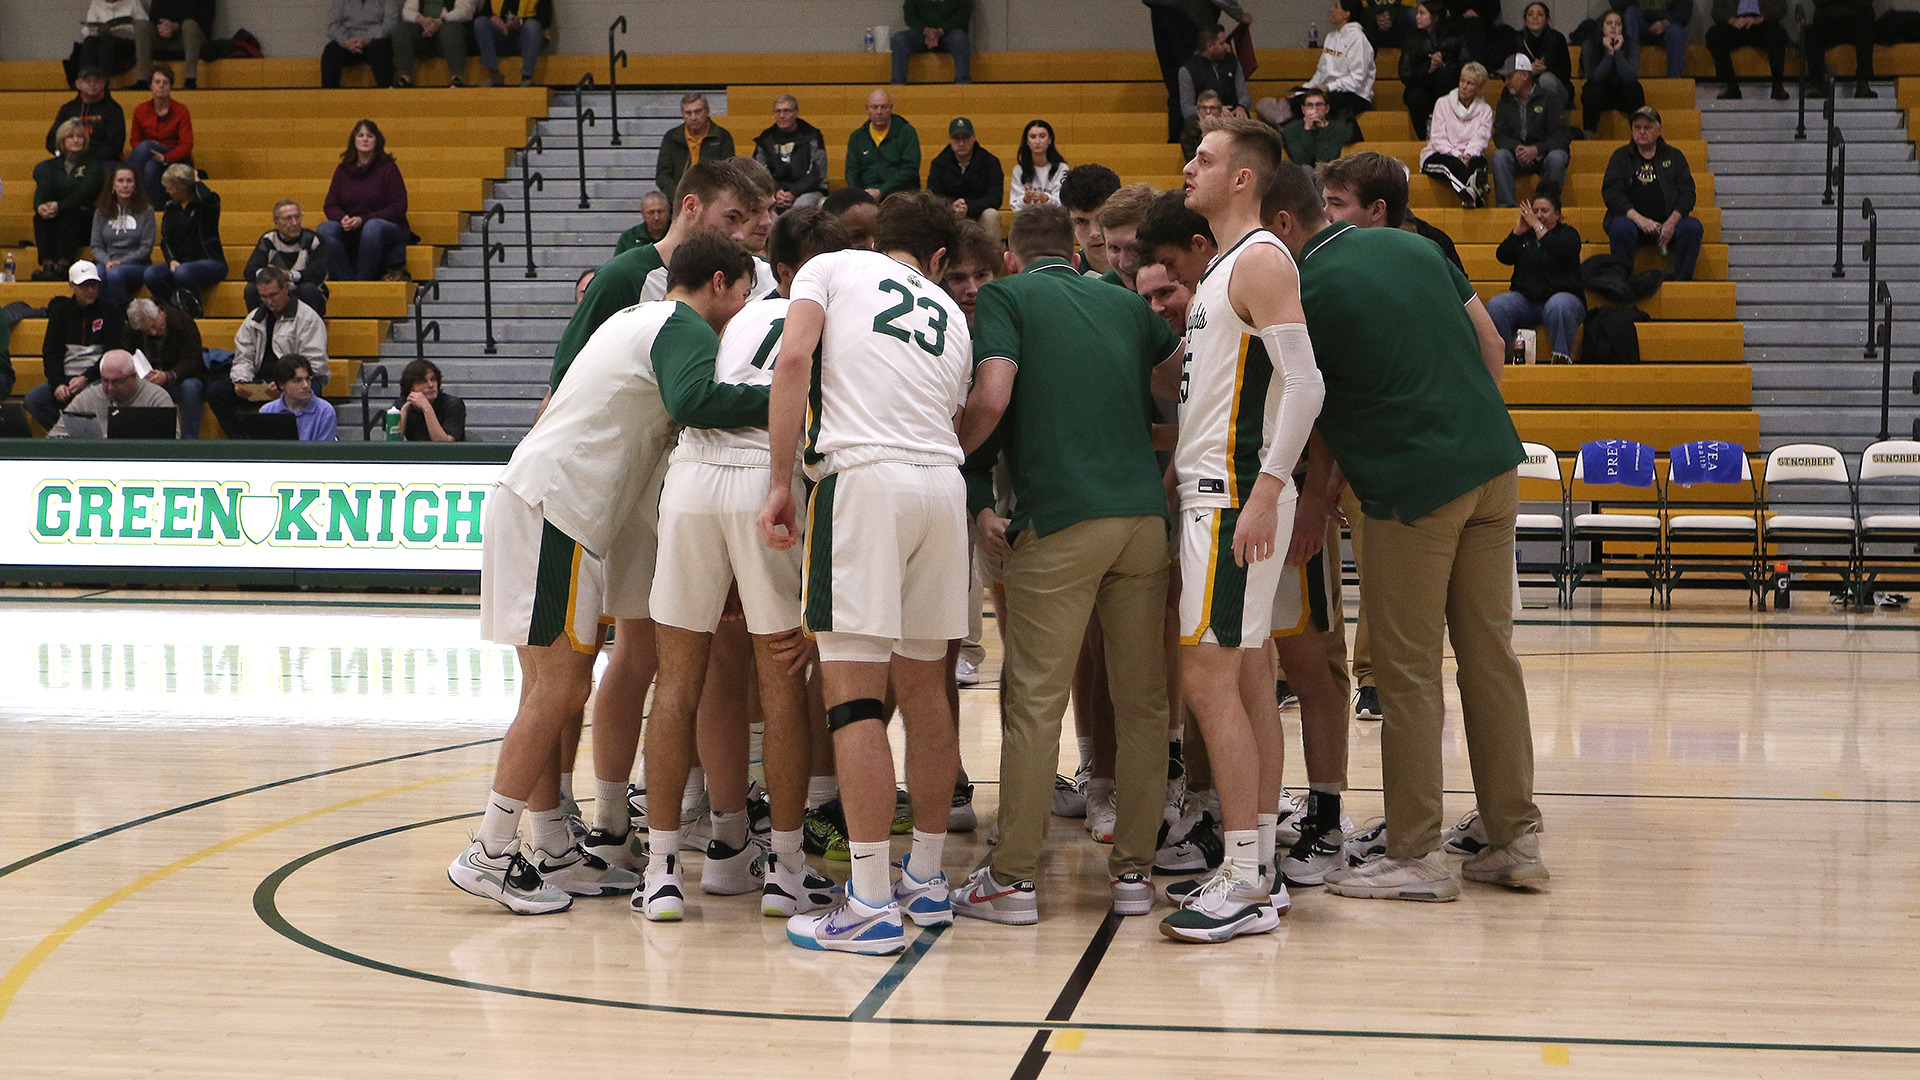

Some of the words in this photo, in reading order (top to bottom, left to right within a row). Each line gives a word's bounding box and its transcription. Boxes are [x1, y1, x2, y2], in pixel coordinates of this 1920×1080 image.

[751, 317, 786, 371] 1
[872, 278, 948, 357] 23
[34, 484, 246, 542] GREEN
[1777, 577, 1788, 589] G
[1123, 872, 1138, 881] NIKE
